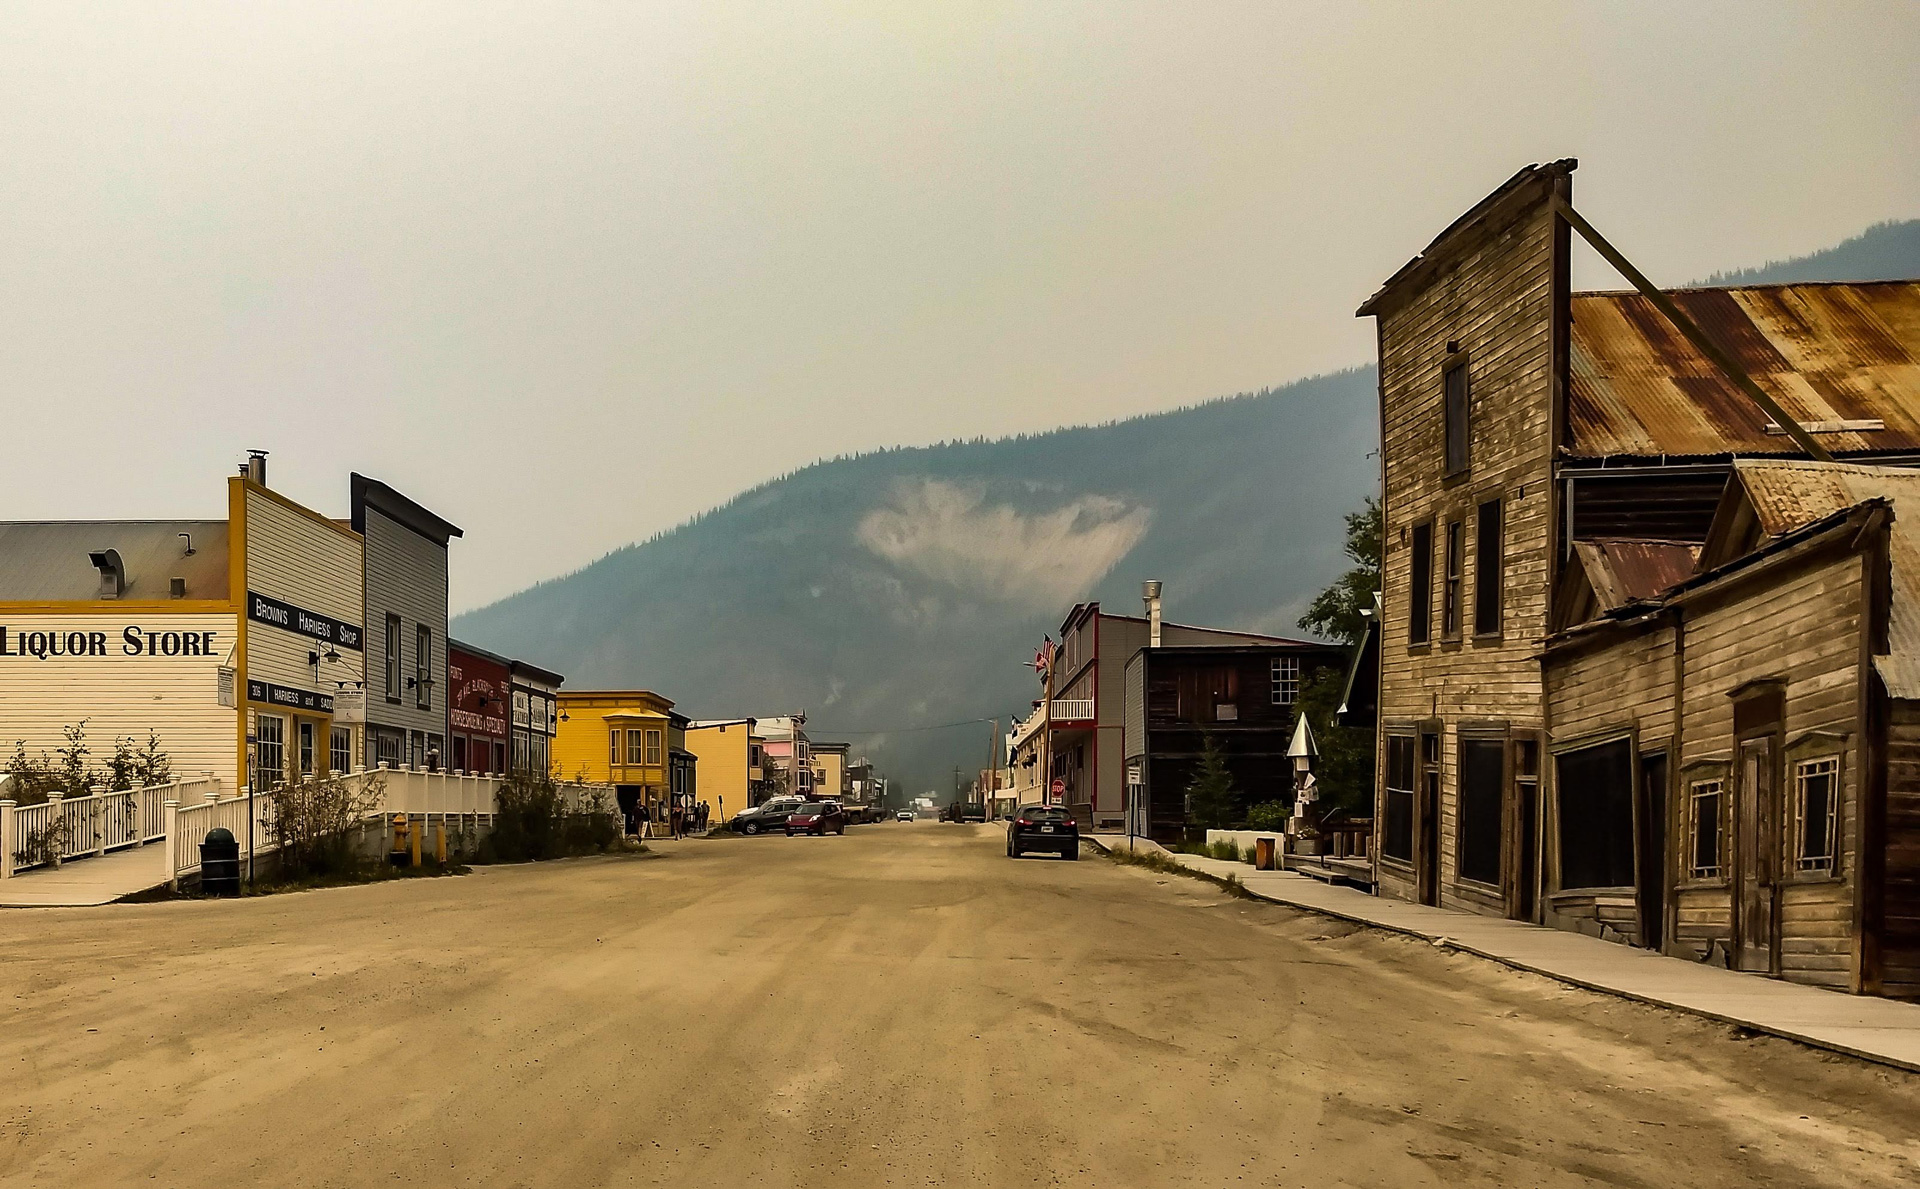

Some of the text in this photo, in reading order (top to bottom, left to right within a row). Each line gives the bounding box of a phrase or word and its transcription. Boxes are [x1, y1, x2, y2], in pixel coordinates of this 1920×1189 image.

[299, 612, 331, 637] HARNESS
[0, 626, 218, 660] LIQUOR STORE
[274, 689, 299, 704] HARNESS
[305, 696, 314, 706] and
